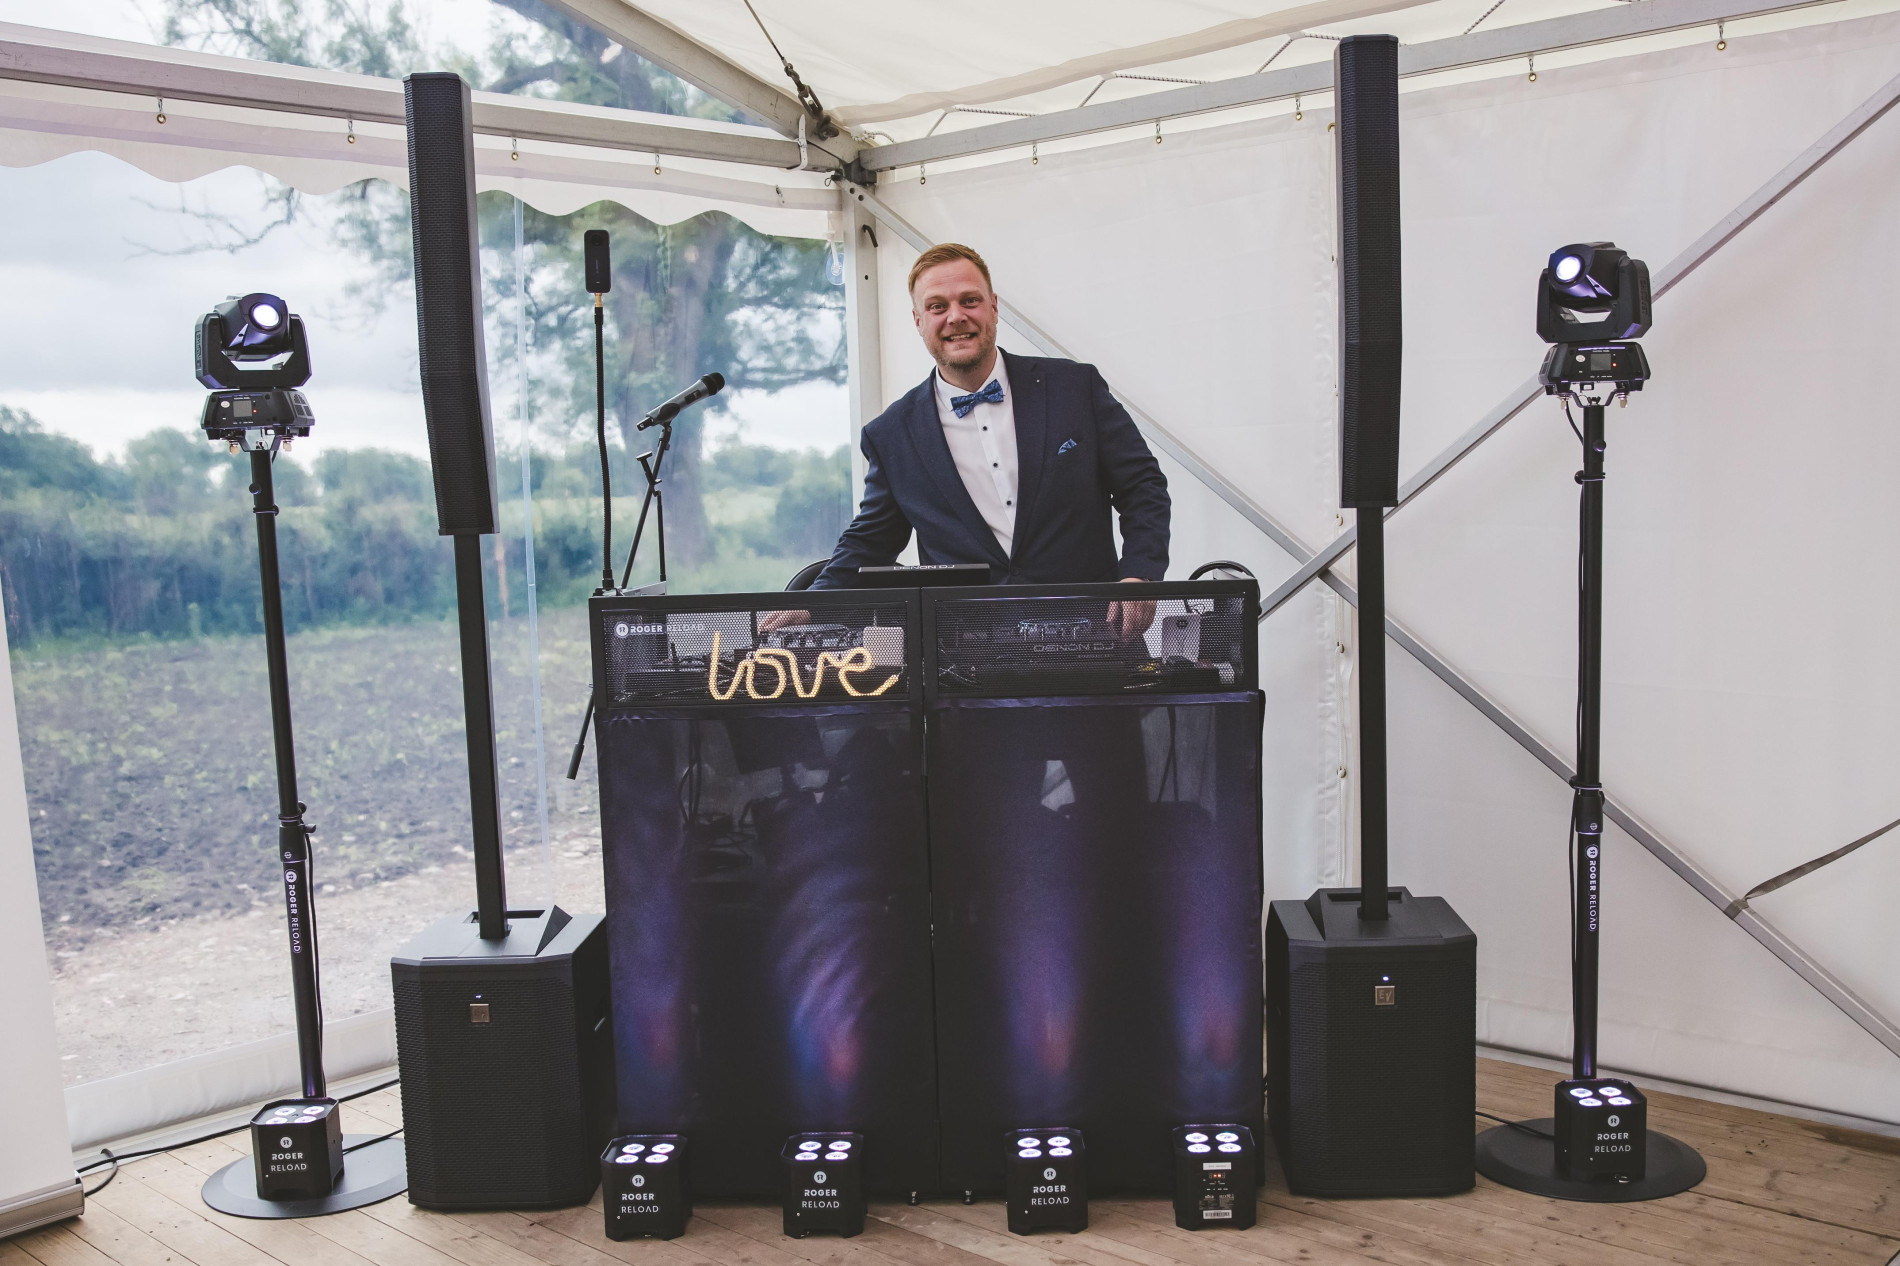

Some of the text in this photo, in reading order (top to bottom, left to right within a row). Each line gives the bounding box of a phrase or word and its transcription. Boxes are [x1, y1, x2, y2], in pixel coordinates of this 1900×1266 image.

[630, 625, 663, 633] ROGER
[666, 623, 705, 632] RELOAD
[708, 631, 899, 700] love
[1589, 860, 1597, 891] ROGER
[288, 884, 298, 914] ROGER
[1589, 894, 1597, 930] RELOAD
[291, 917, 301, 952] RELOAD
[1597, 1132, 1629, 1141] ROGER
[1594, 1144, 1631, 1153] RELOAD
[271, 1152, 304, 1160] ROGER
[270, 1163, 307, 1172] RELOAD
[804, 1189, 837, 1197] ROGER
[1033, 1185, 1066, 1194] ROGER
[621, 1193, 655, 1201] ROGER
[1031, 1196, 1070, 1205] RELOAD
[802, 1200, 840, 1208] RELOAD
[621, 1205, 659, 1214] RELOAD
